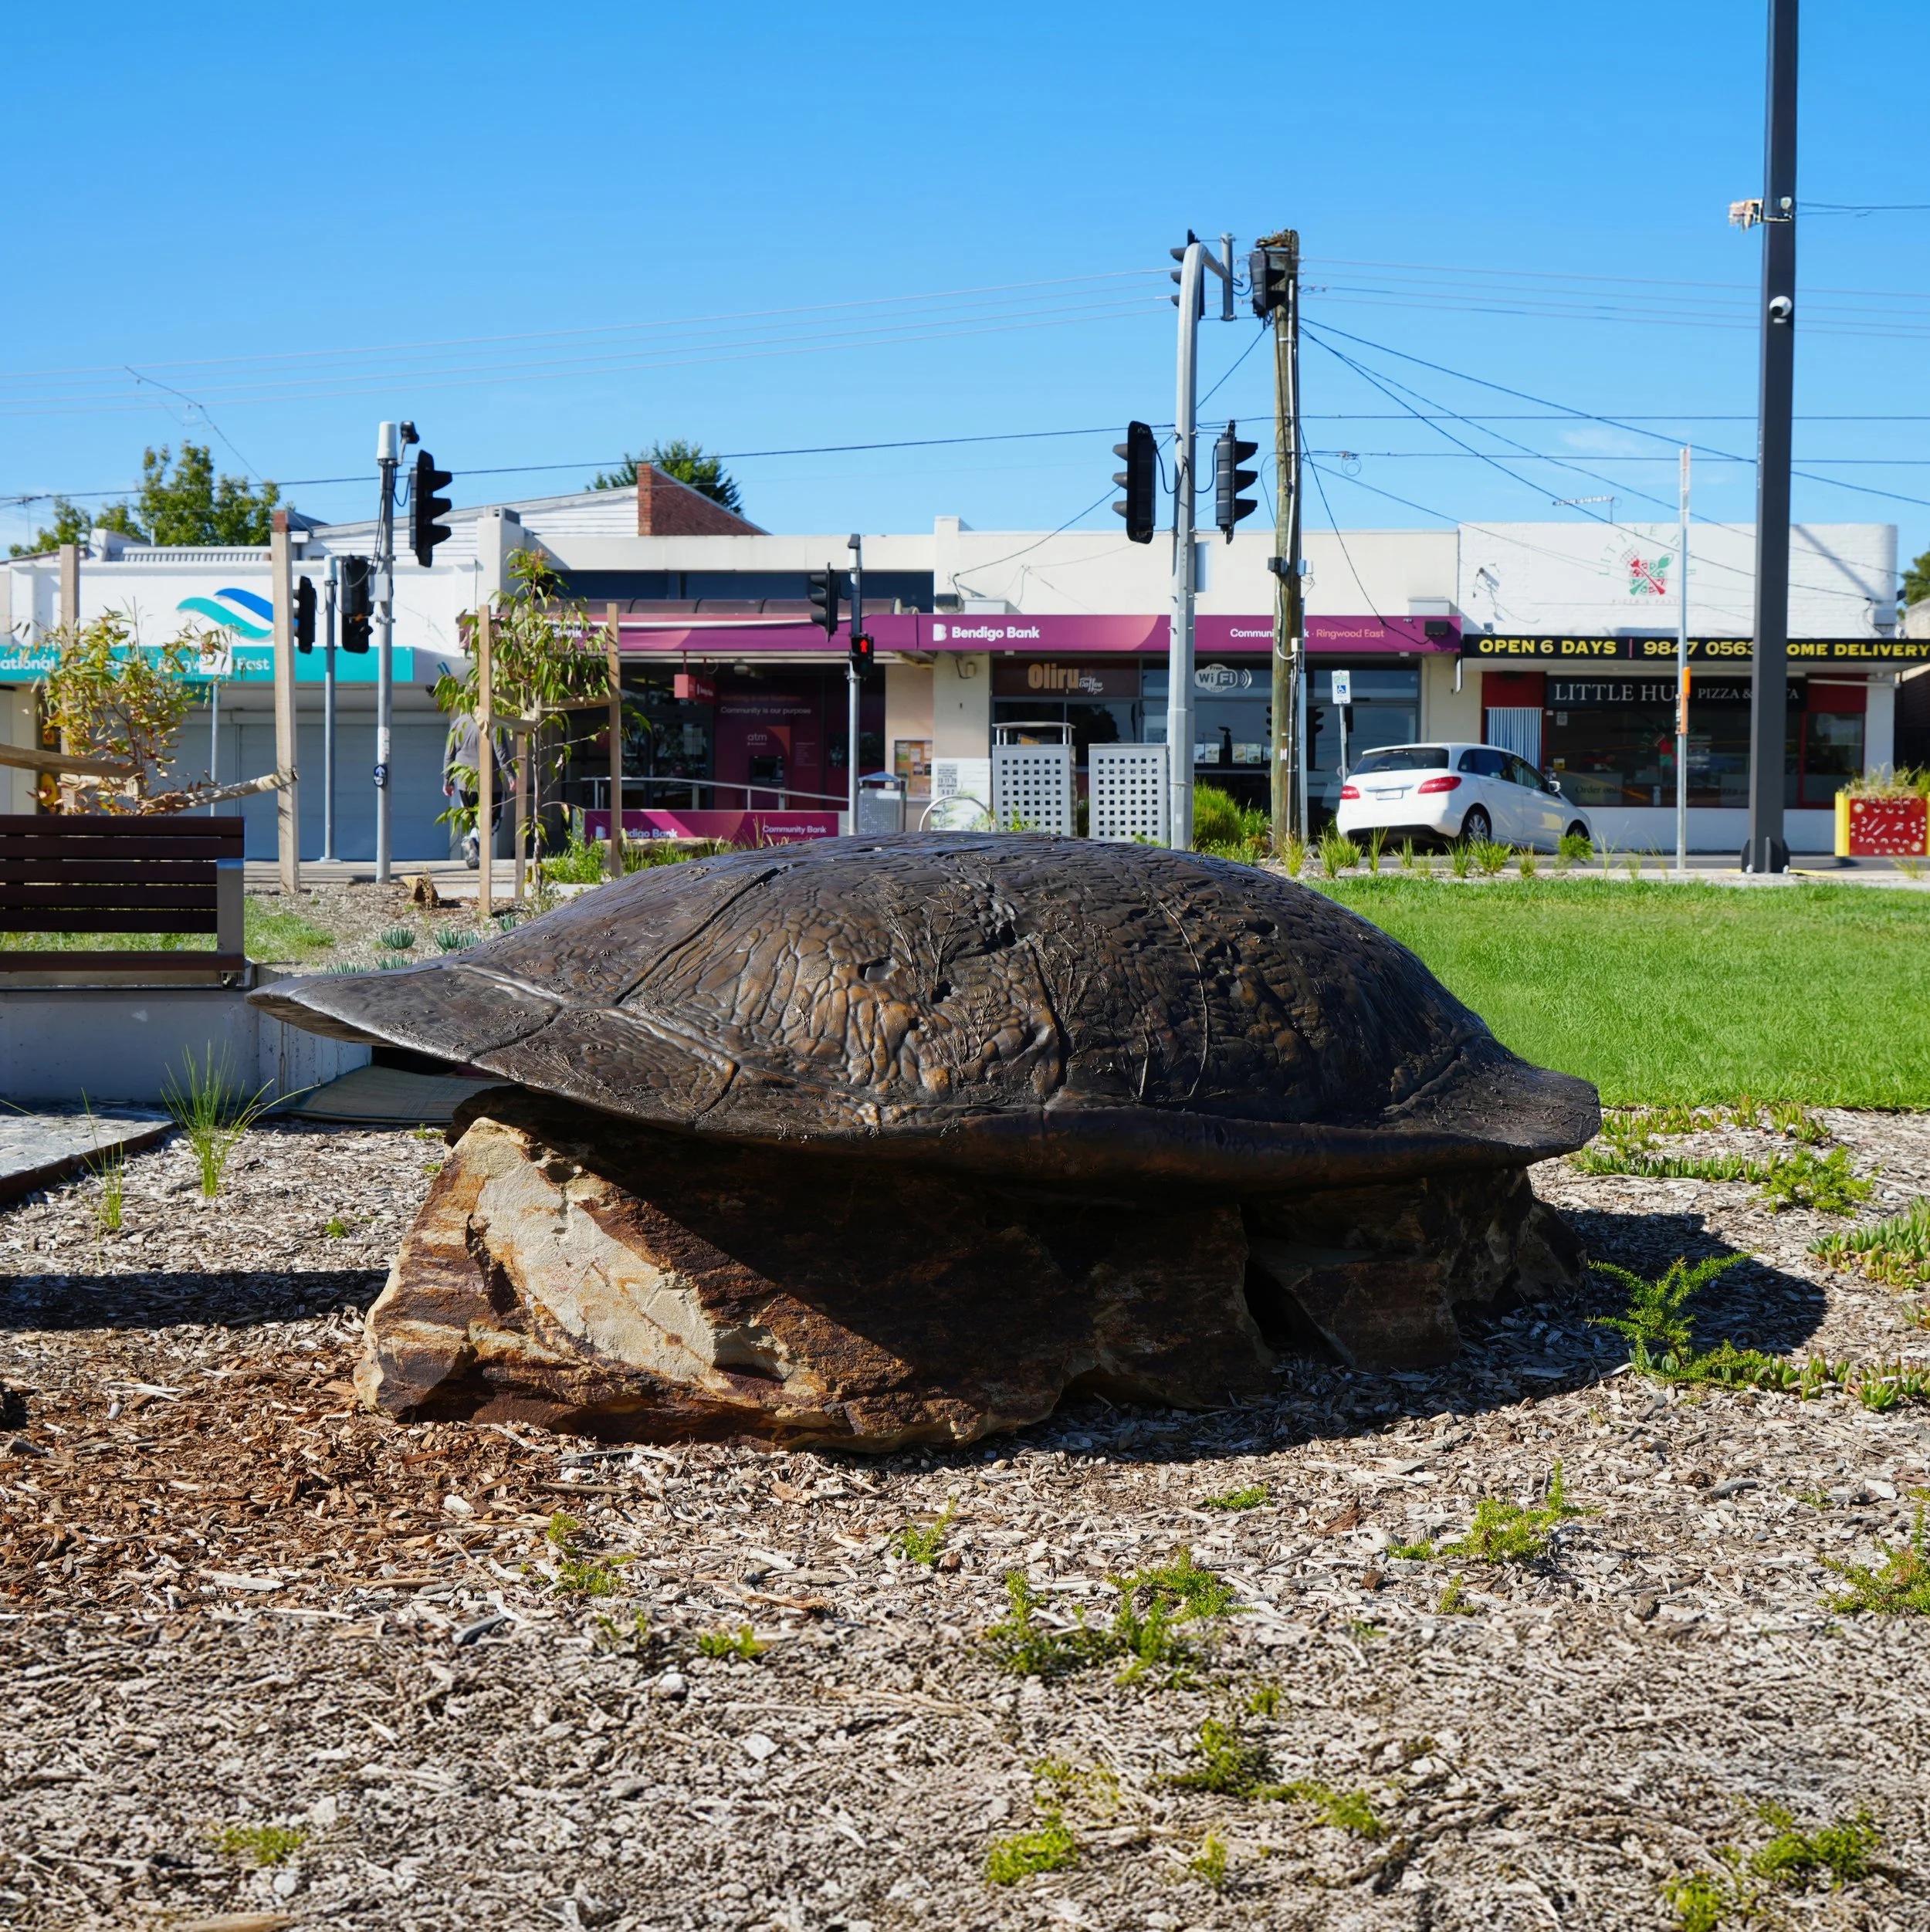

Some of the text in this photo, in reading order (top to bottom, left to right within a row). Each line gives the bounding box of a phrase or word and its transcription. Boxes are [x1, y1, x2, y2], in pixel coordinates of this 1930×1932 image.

[951, 626, 1004, 641] Bendigo
[1006, 626, 1040, 638] Bank
[1230, 628, 1274, 638] Communi
[1316, 628, 1362, 640] Ringwood
[1364, 628, 1384, 638] East
[1479, 639, 1617, 655] OPEN 6 DAYS
[1786, 643, 1930, 657] OME DELIVERY
[1028, 663, 1079, 689] Oliru
[1553, 683, 1677, 702] LITTLE HU
[1698, 688, 1740, 699] PIZZA
[720, 706, 761, 716] Community
[747, 733, 767, 742] atm
[652, 827, 678, 839] Bank
[763, 824, 827, 835] Community Bank
